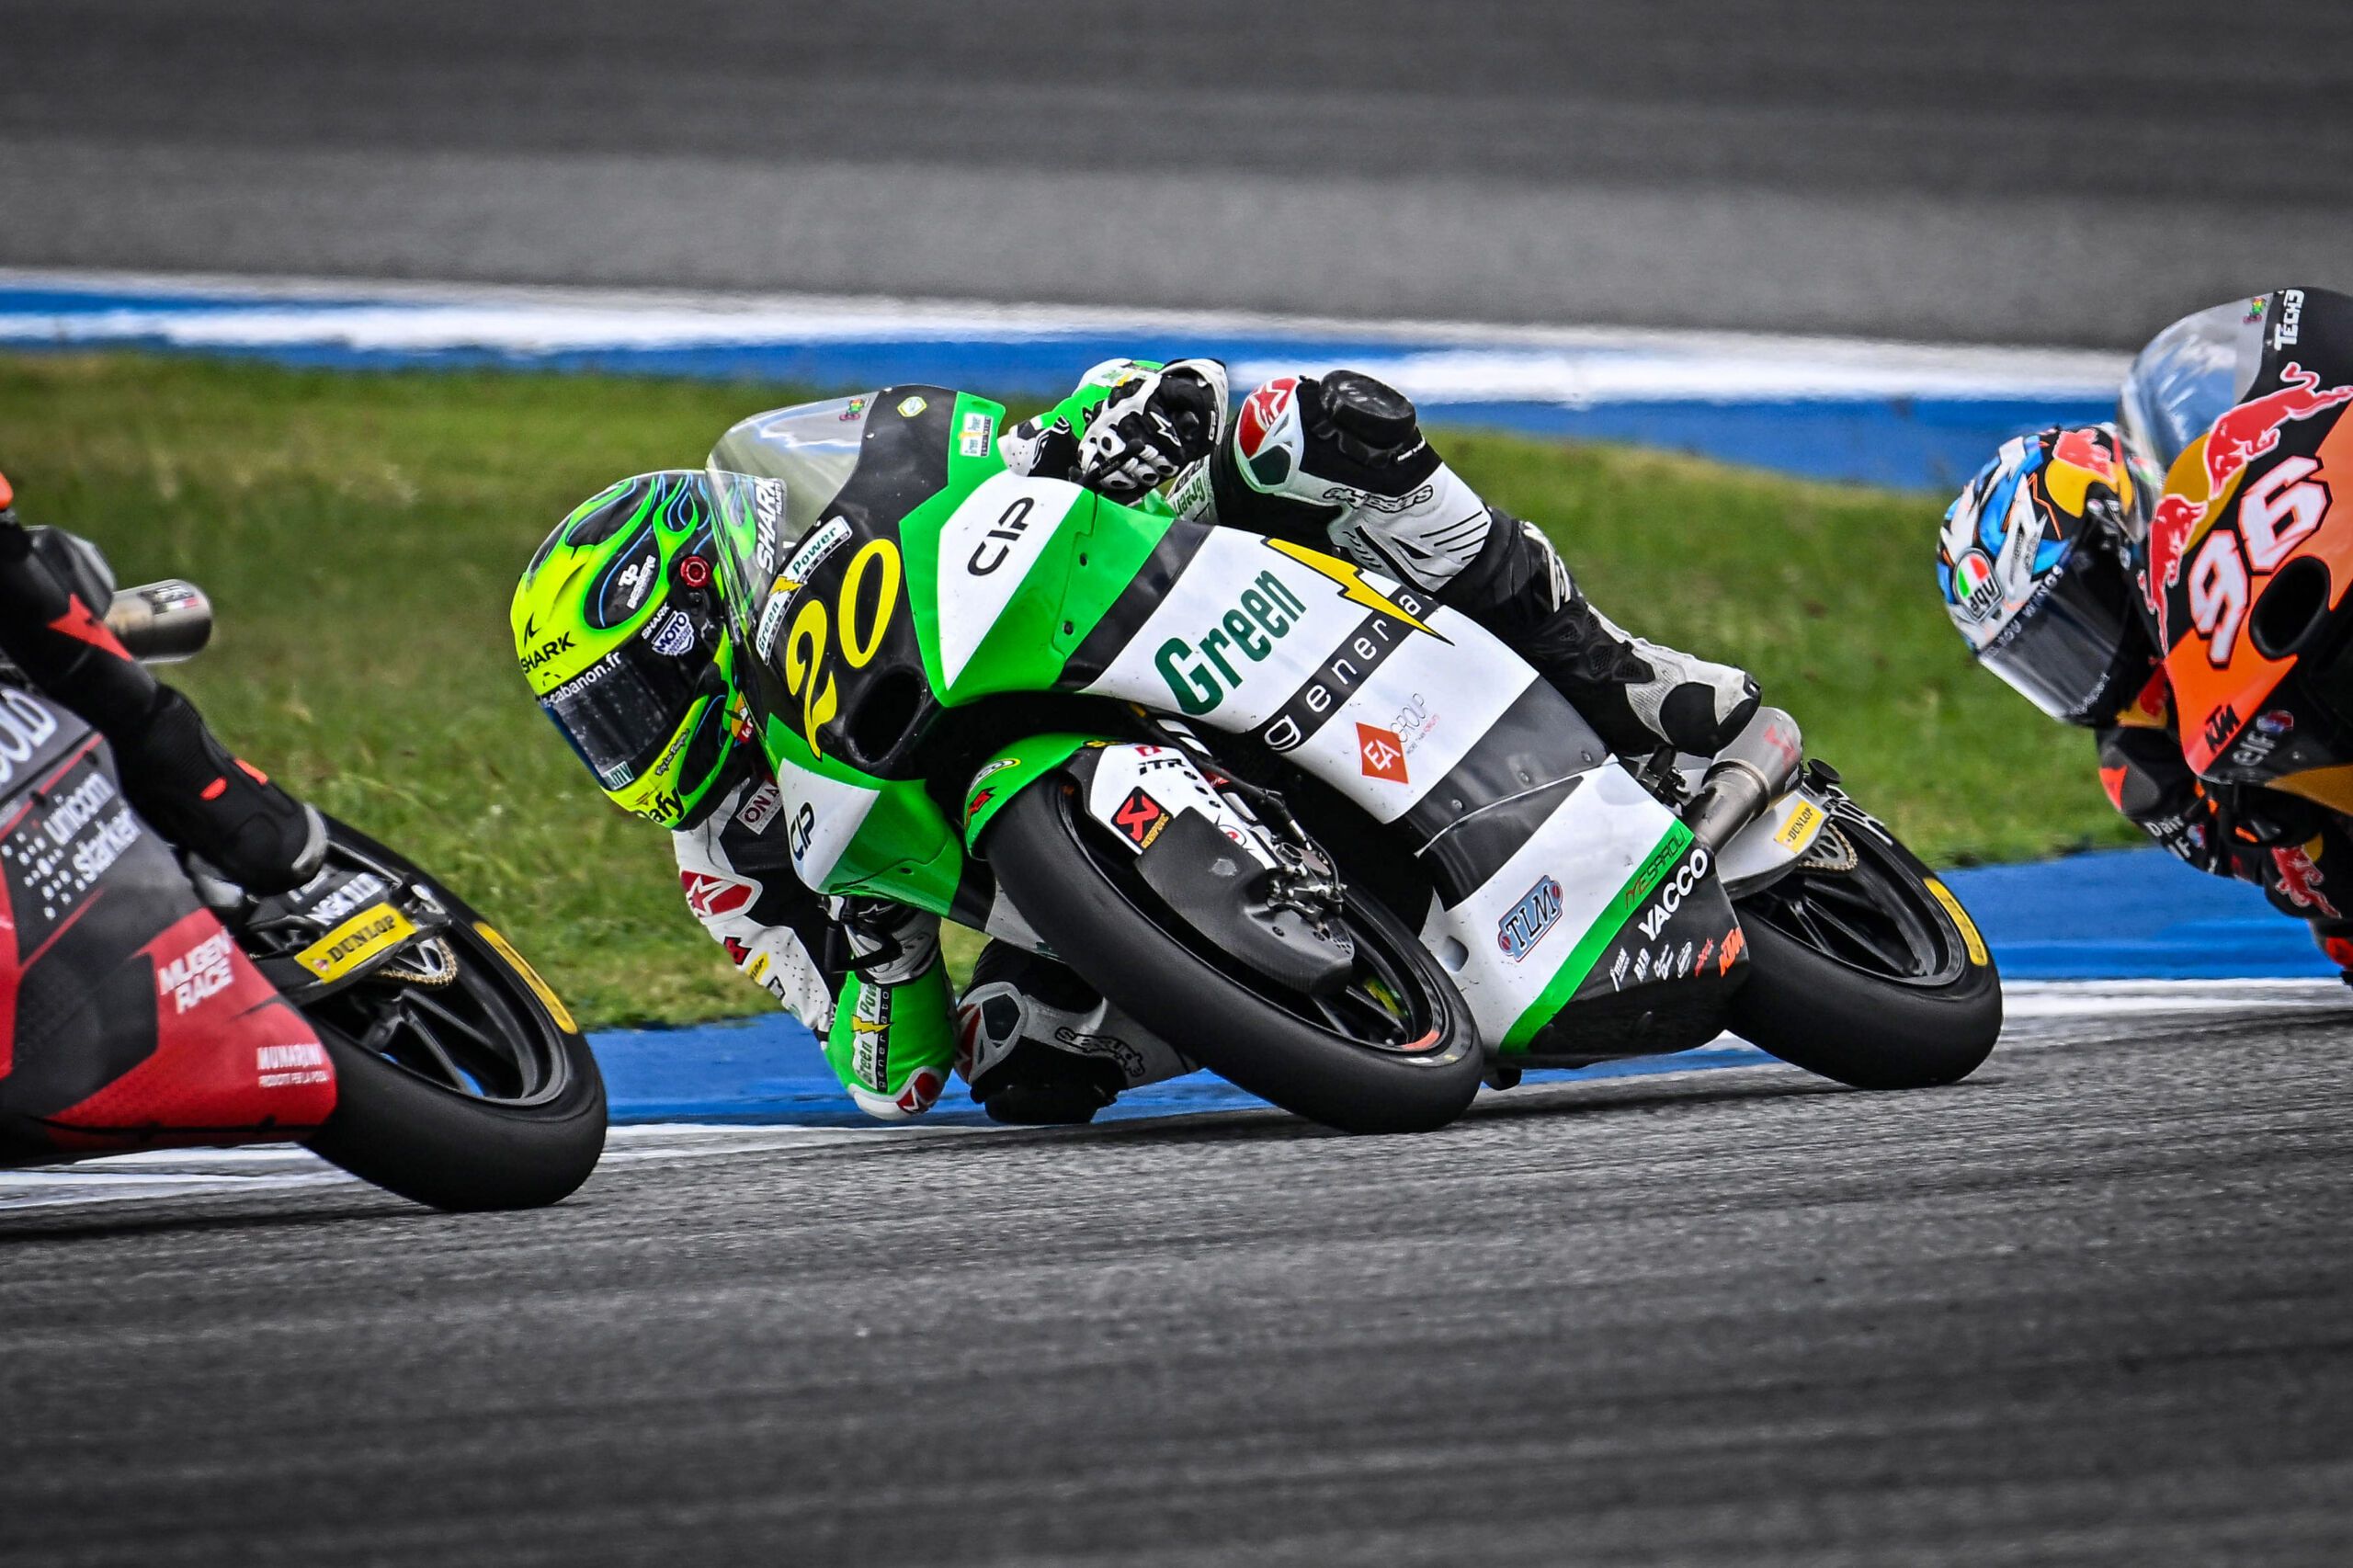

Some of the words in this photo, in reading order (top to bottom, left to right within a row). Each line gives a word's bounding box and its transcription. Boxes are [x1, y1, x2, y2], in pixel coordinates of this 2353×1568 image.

[967, 496, 1035, 576] CIP
[2189, 454, 2334, 670] 96
[641, 601, 671, 641] SHARK
[758, 600, 779, 652] Green
[792, 526, 836, 575] Power
[520, 631, 575, 675] SHARK
[655, 613, 688, 654] MOTO
[785, 538, 902, 759] 20
[1154, 570, 1306, 715] Green
[1264, 593, 1432, 753] genera
[639, 787, 681, 825] afy
[743, 794, 770, 824] ON
[790, 801, 816, 862] CIP
[1788, 806, 1813, 842] DUNLOP
[1505, 885, 1558, 949] TLM
[1638, 848, 1708, 941] YACCO
[158, 925, 230, 996] MUGEN
[327, 914, 396, 963] DUNLOP
[176, 958, 234, 1015] RACE
[878, 990, 889, 1089] generato
